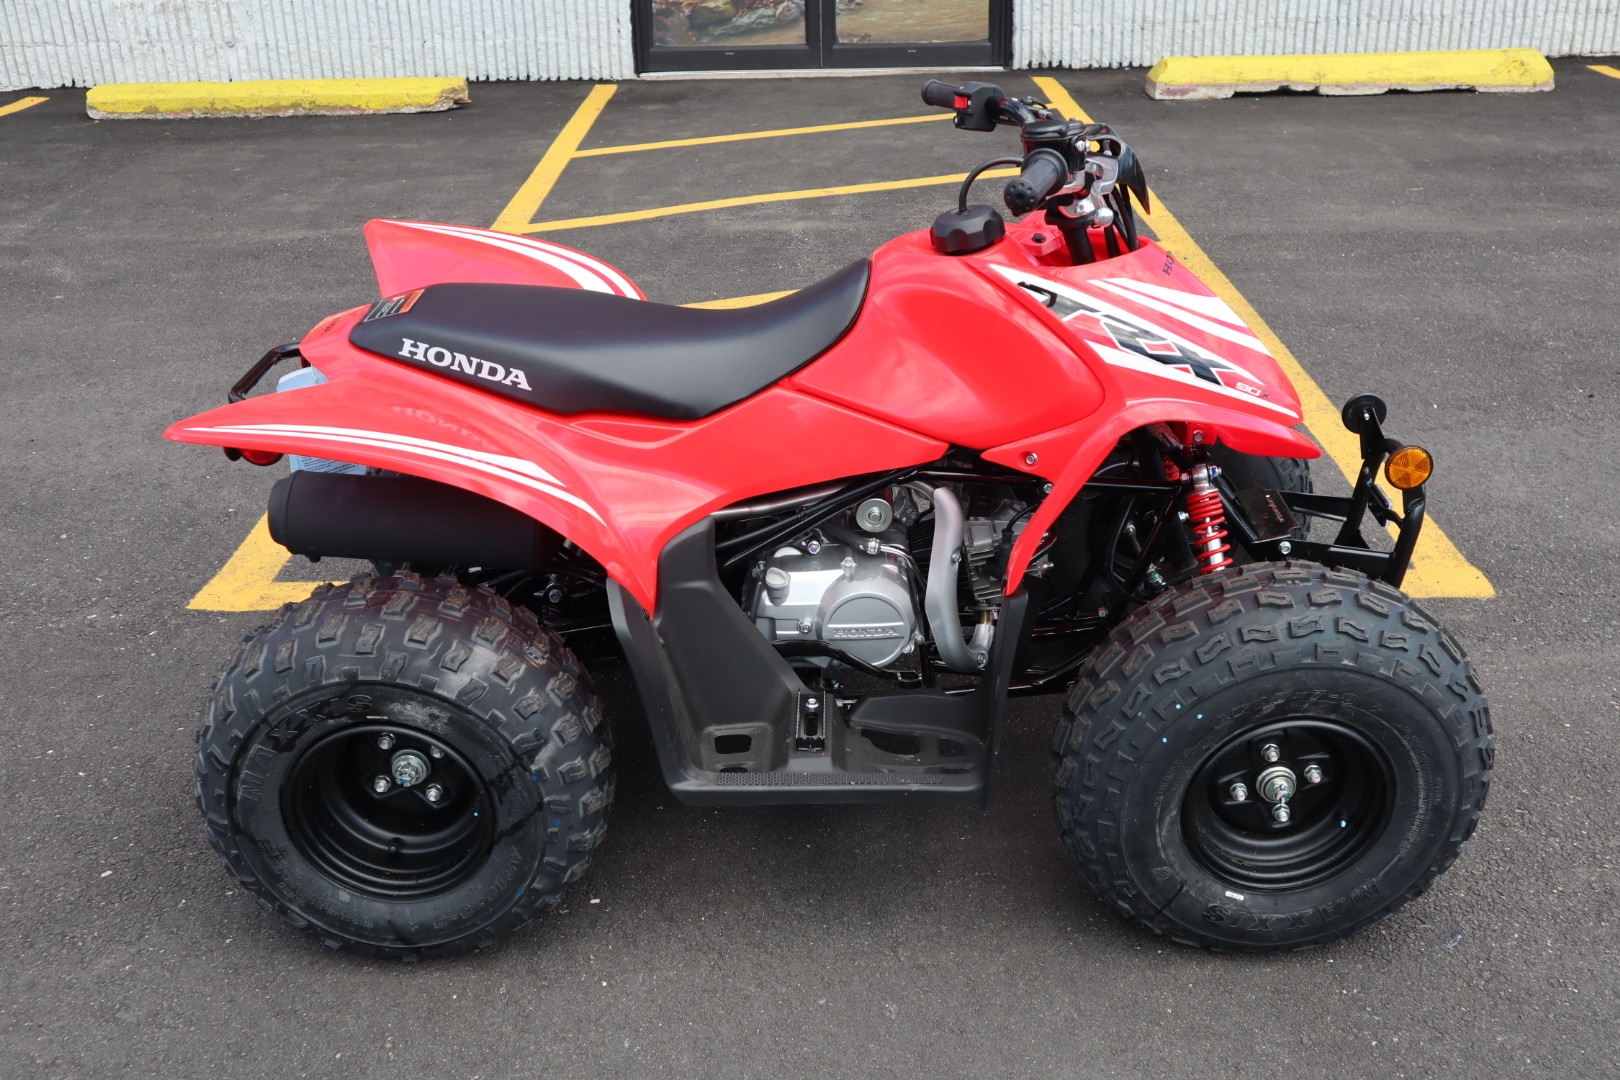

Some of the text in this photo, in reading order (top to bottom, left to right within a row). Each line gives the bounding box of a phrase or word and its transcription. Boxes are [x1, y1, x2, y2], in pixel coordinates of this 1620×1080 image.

[398, 337, 532, 391] HONDA
[834, 627, 899, 638] HONDA
[241, 693, 376, 802] MAXXIS
[1200, 879, 1382, 932] MAXXIS
